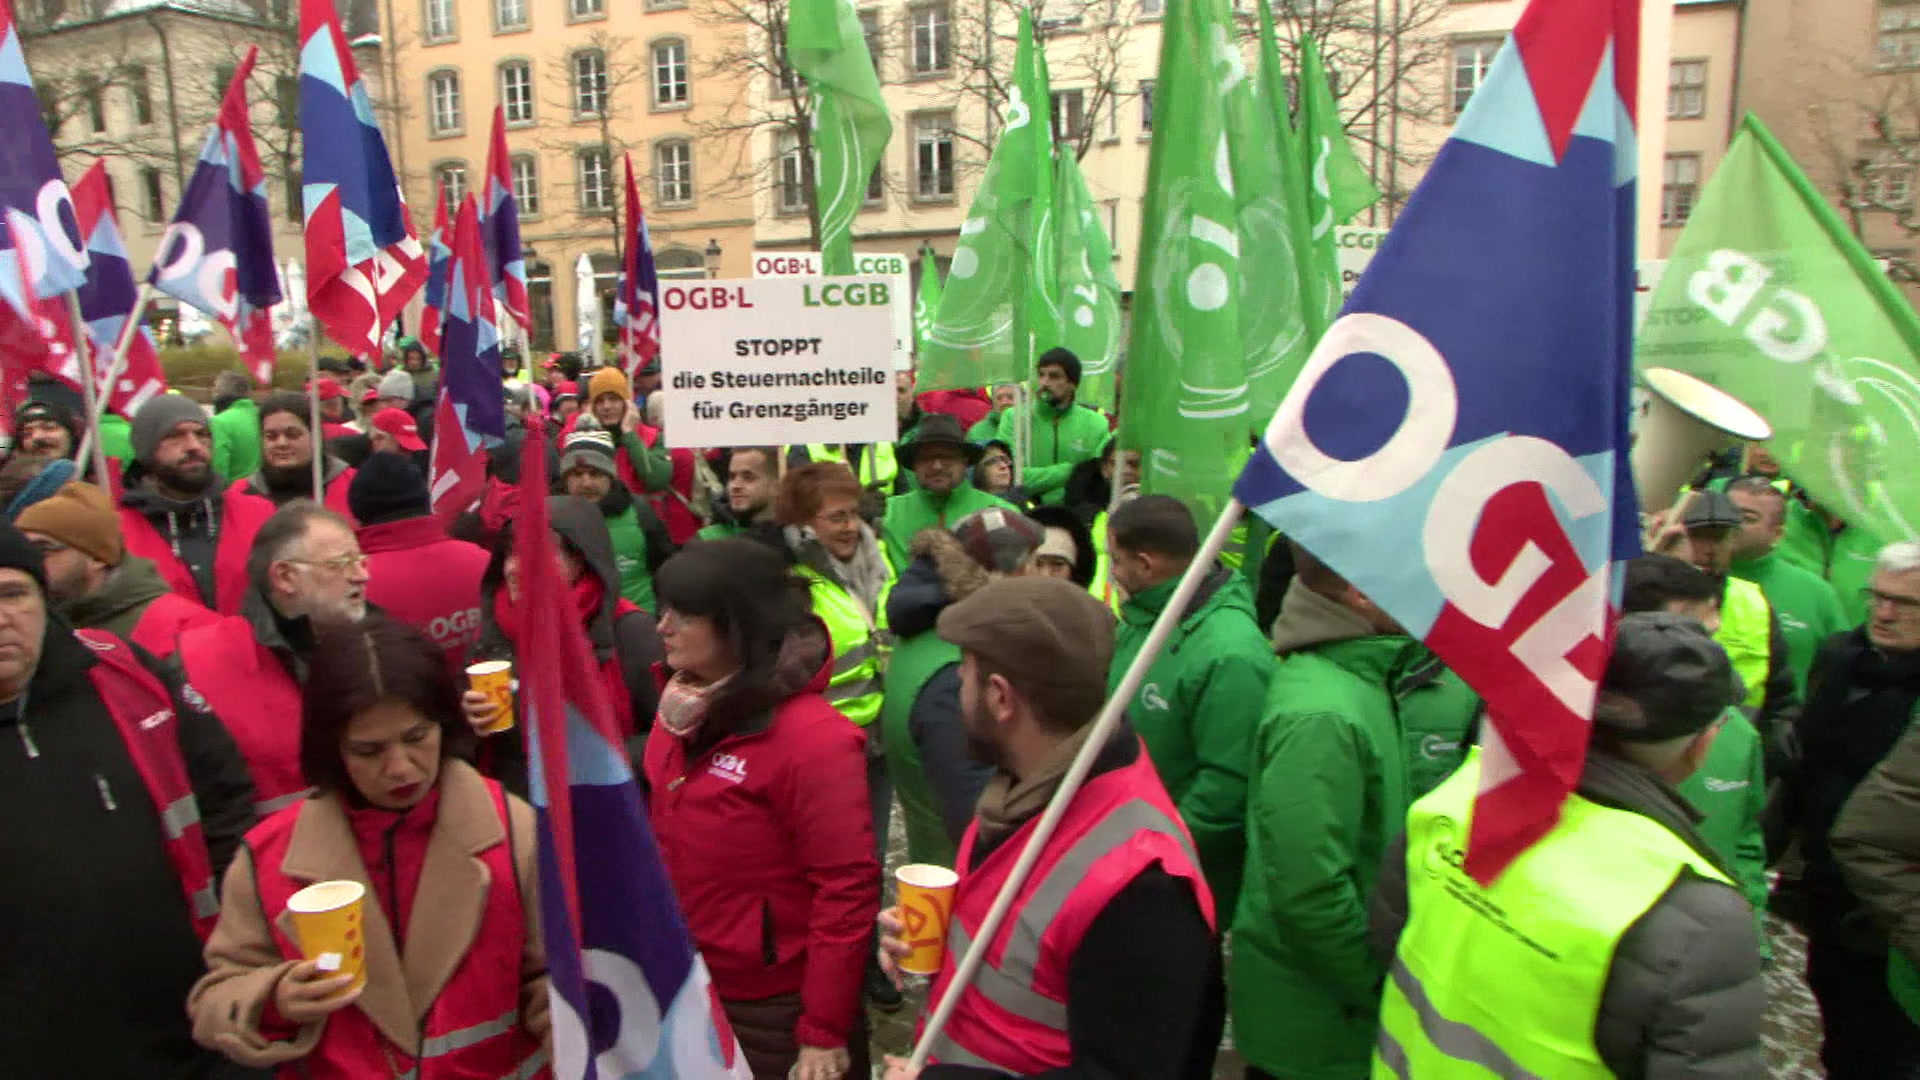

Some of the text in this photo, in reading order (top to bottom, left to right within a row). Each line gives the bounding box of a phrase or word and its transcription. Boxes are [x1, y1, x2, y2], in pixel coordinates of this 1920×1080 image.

[854, 257, 903, 275] CGB
[803, 283, 890, 307] LCGB
[735, 338, 822, 357] STOPPT
[672, 367, 886, 389] die Steuernachteile
[692, 399, 869, 421] für Grenzgänger
